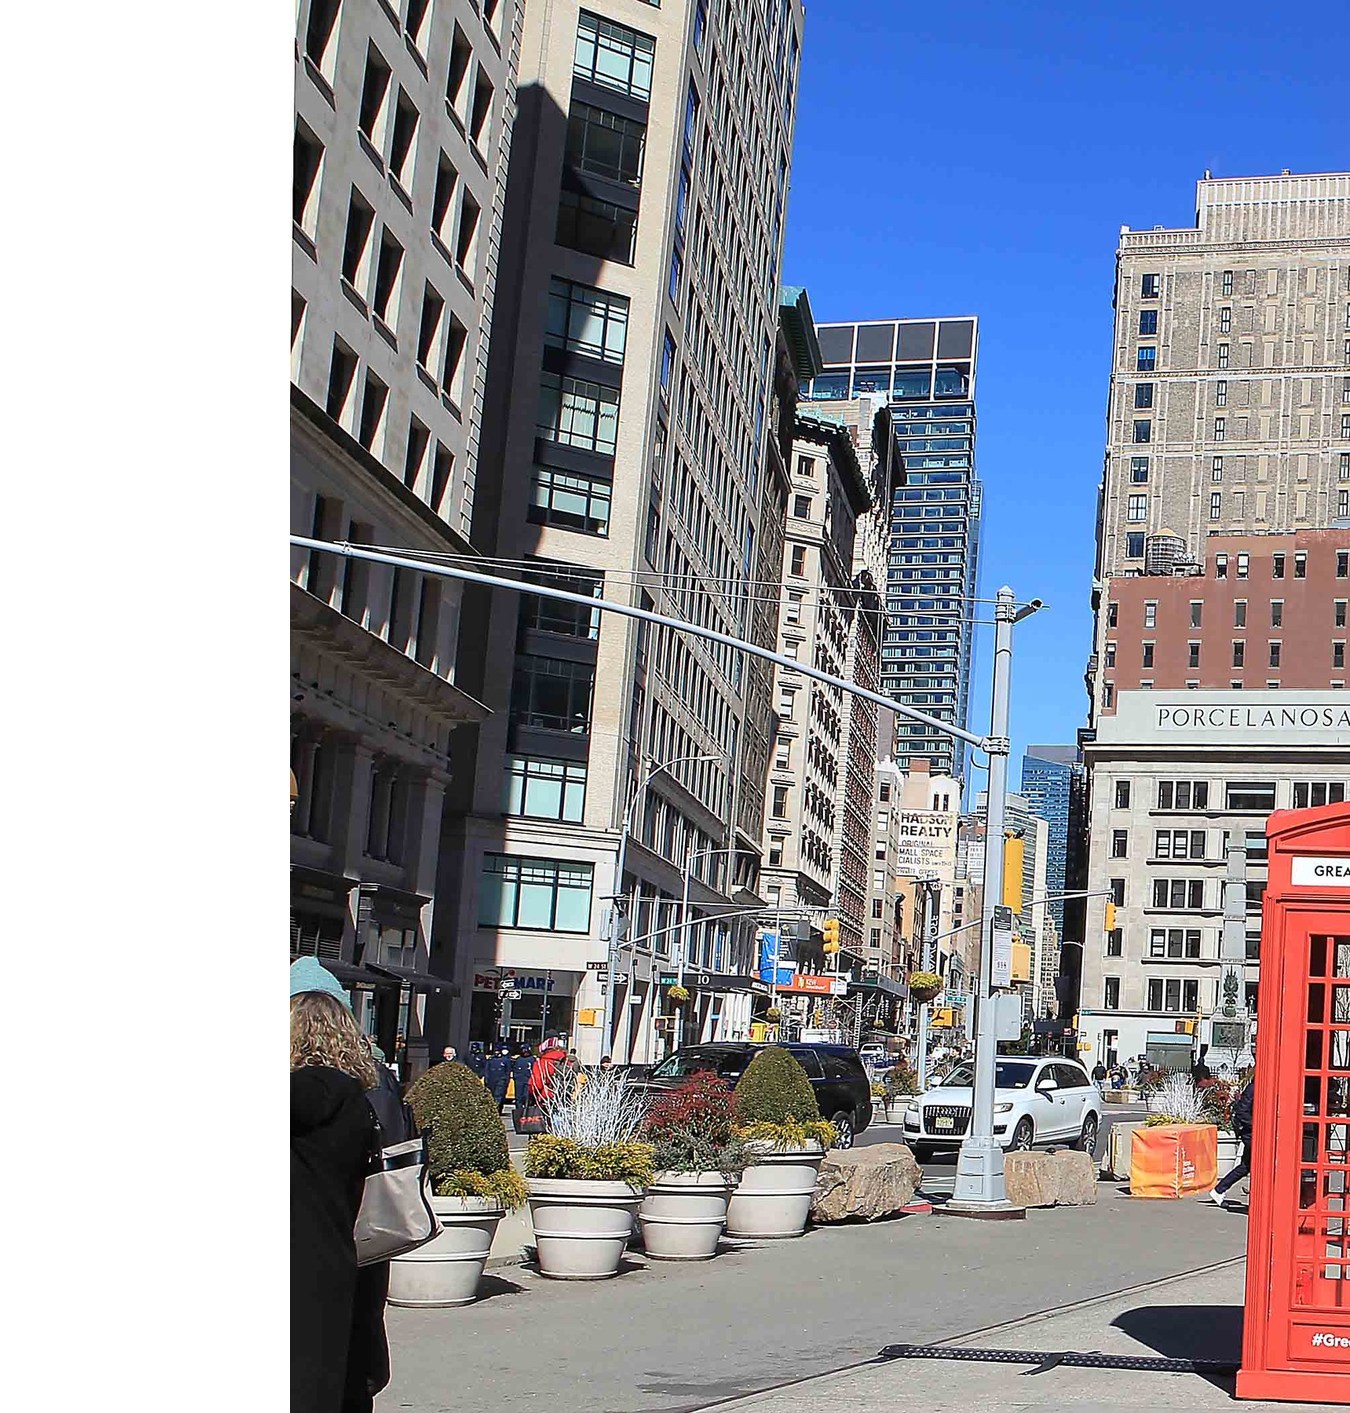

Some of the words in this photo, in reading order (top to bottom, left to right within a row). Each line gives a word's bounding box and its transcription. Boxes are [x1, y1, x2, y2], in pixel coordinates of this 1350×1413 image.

[901, 826, 952, 837] REALTY
[920, 849, 943, 857] SPACE
[474, 974, 555, 991] PETMART
[697, 975, 710, 985] 10
